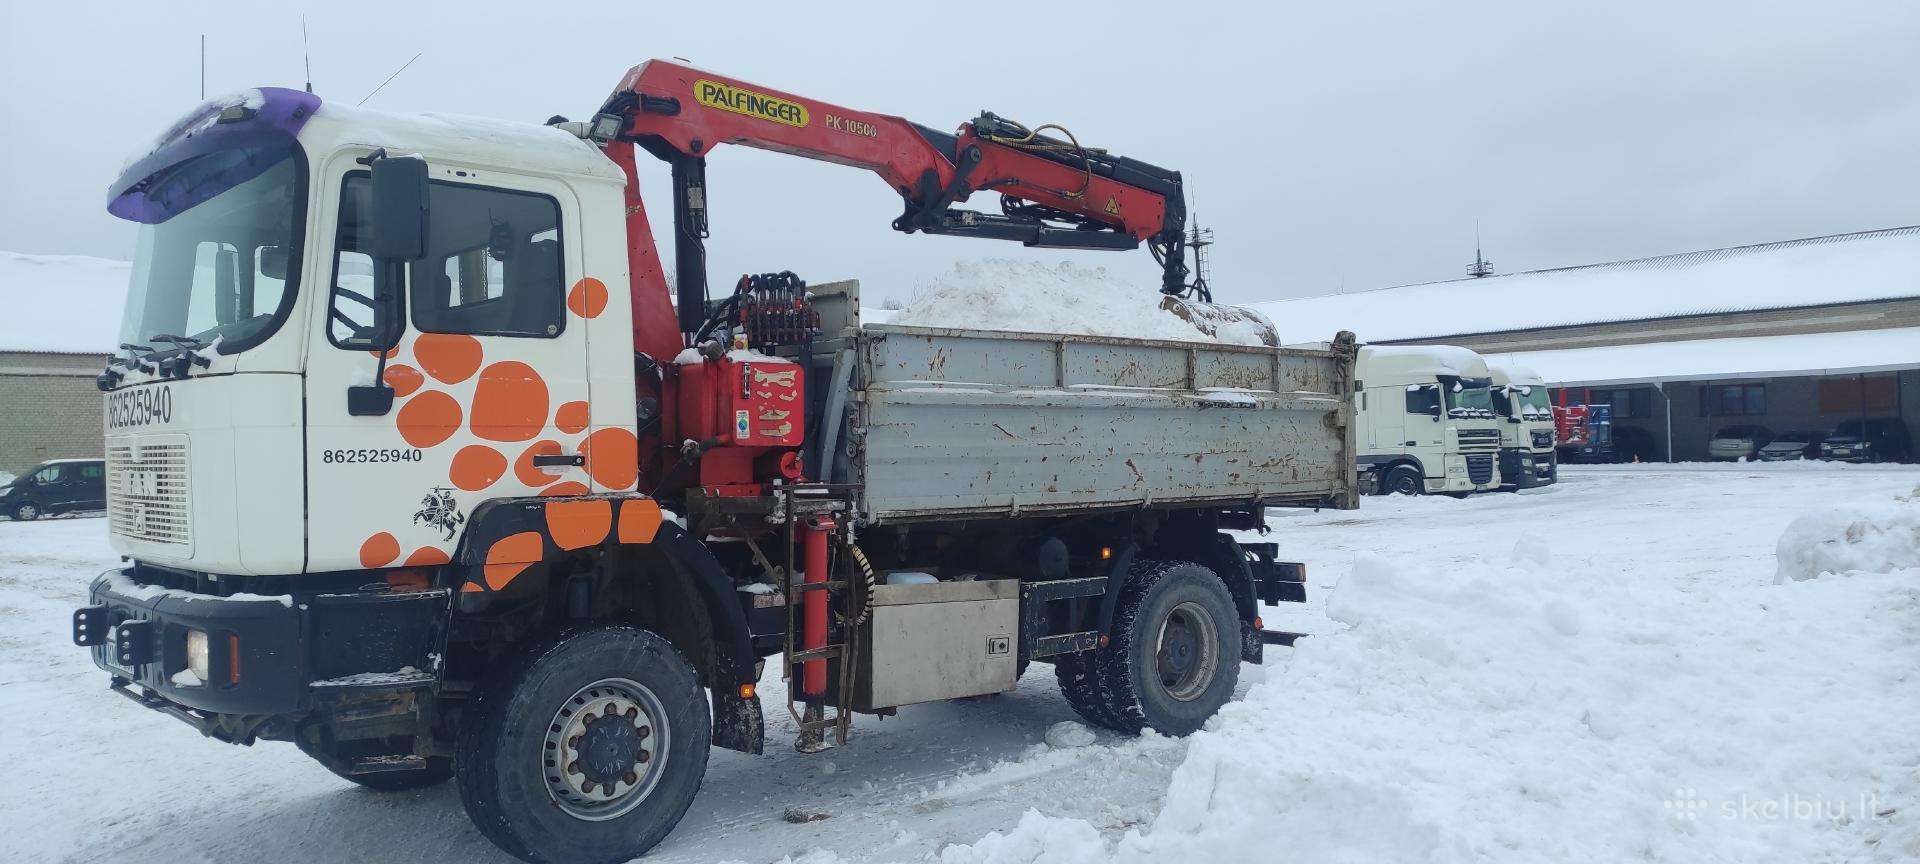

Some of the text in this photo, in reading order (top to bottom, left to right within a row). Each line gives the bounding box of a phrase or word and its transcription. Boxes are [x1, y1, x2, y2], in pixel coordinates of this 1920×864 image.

[702, 83, 801, 124] PALFINGER
[825, 114, 842, 130] PK
[108, 385, 172, 428] 862525940
[323, 448, 422, 464] 862525940
